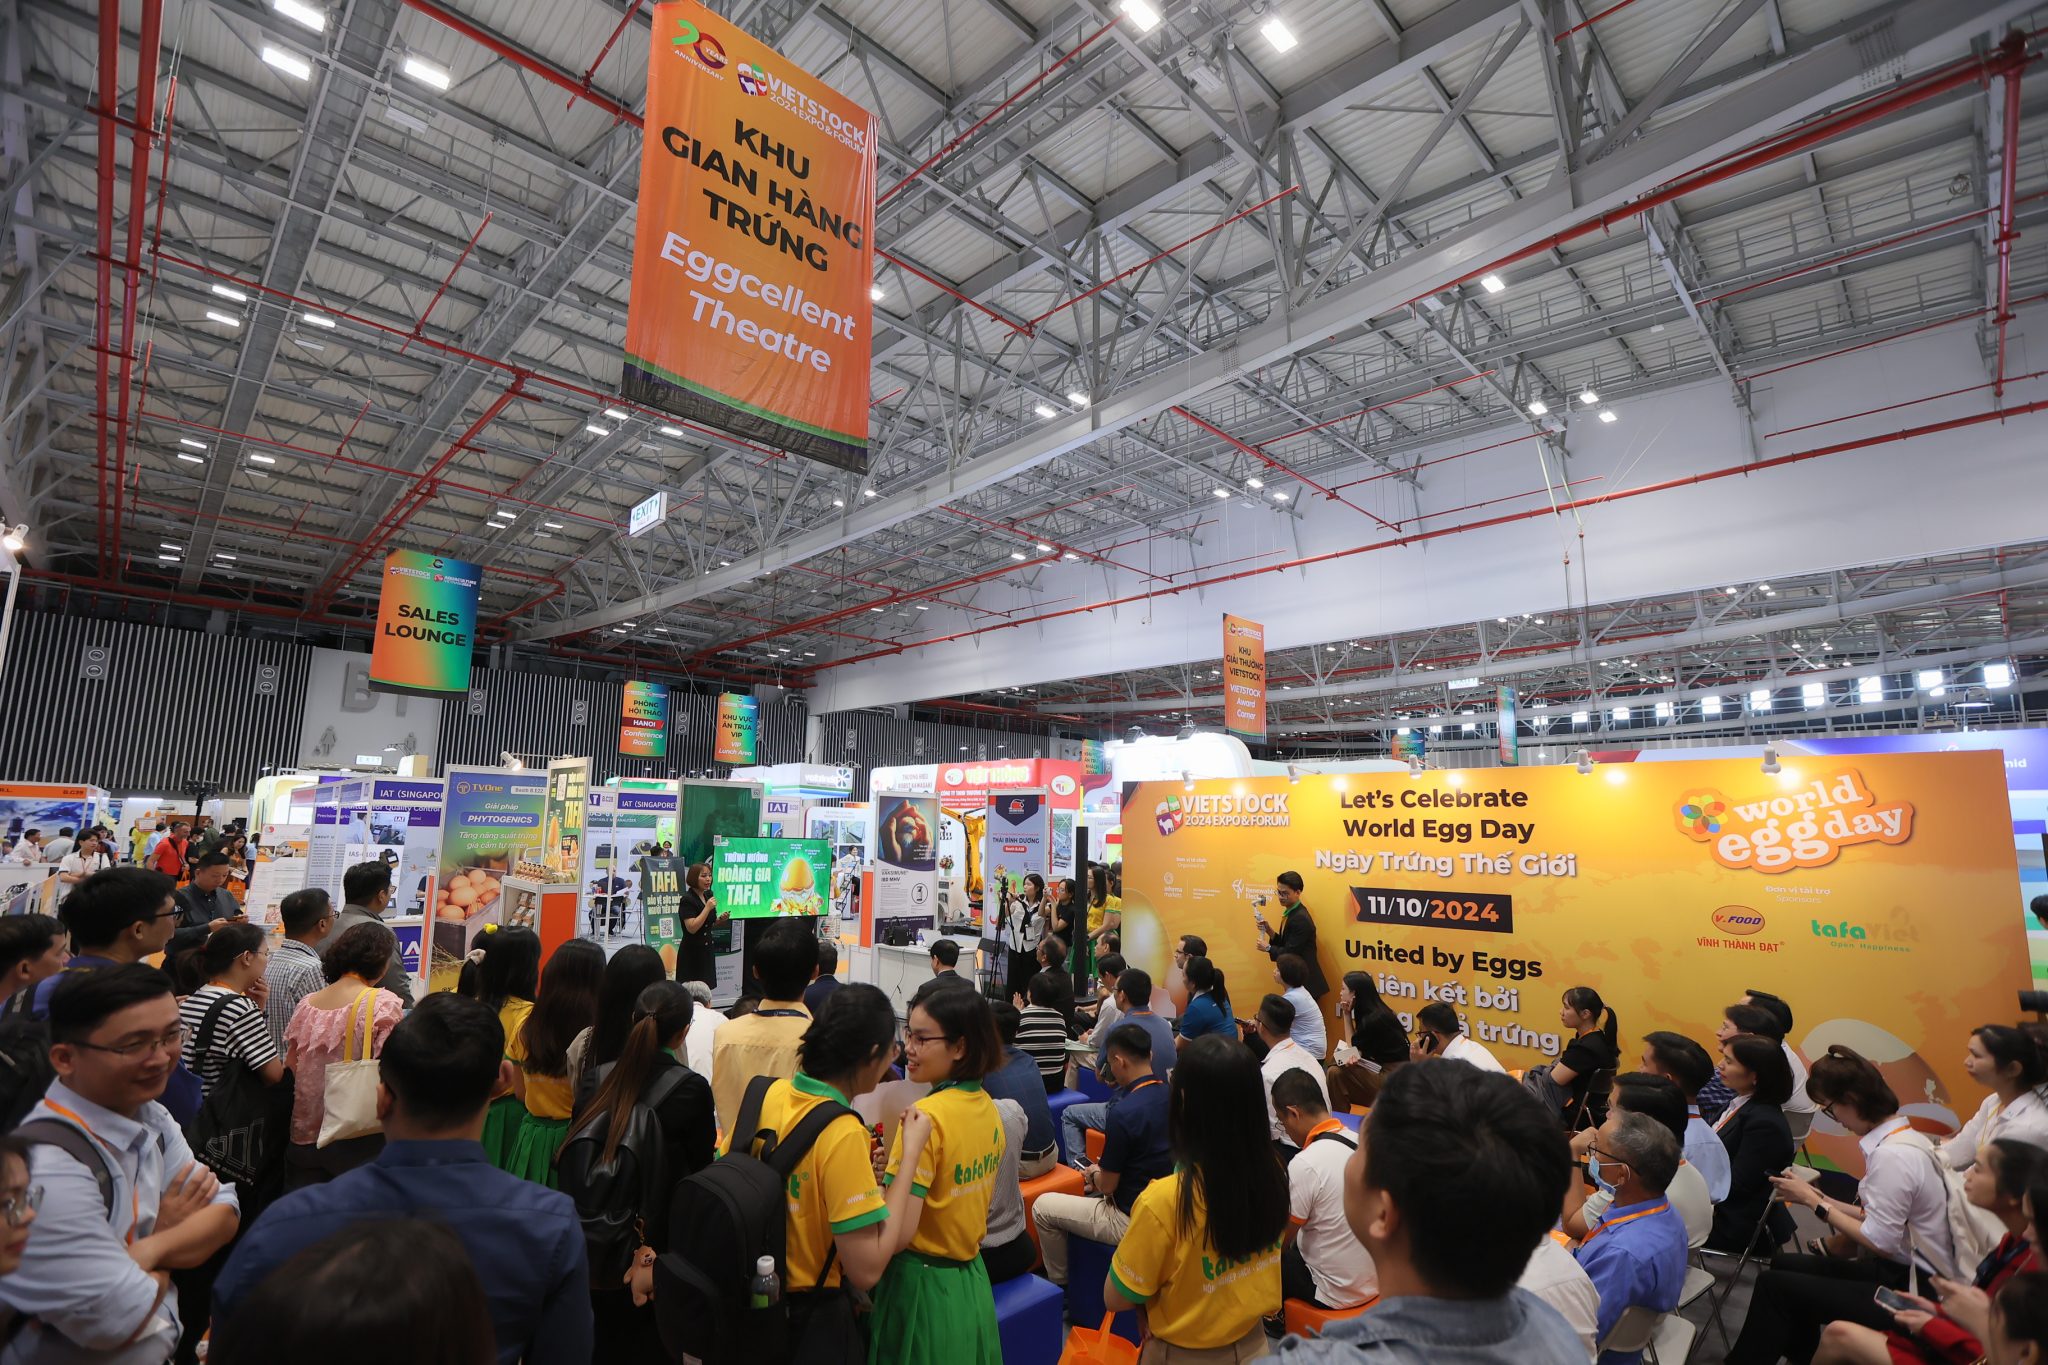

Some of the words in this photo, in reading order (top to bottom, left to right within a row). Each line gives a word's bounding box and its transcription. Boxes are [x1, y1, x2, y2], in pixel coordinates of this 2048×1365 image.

[674, 49, 724, 81] ANNIVERSARY
[705, 47, 729, 66] YEARS
[767, 72, 865, 147] VIETSTOCK
[769, 91, 797, 115] 2024
[735, 119, 810, 180] KHU
[662, 126, 757, 196] GIAN
[769, 181, 863, 249] HÀNG
[703, 189, 828, 272] TRỨNG
[660, 231, 856, 341] Eggcellent
[689, 289, 832, 372] Theatre
[636, 499, 655, 521] EXIT
[398, 604, 460, 626] SALES
[385, 623, 467, 647] LOUNGE
[1238, 646, 1251, 656] KHU
[1229, 667, 1261, 681] VIETSTOCK
[1230, 684, 1261, 697] VIETSTOCK
[1236, 698, 1256, 708] Award
[633, 720, 656, 728] HANOI
[1236, 709, 1256, 720] Corner
[624, 729, 663, 739] Conference
[632, 739, 654, 747] Room
[738, 749, 752, 757] Area
[380, 789, 395, 798] IAT
[1182, 793, 1289, 814] VIETSTOCK
[1341, 790, 1394, 809] Let's
[1400, 788, 1529, 808] Celebrate
[1733, 774, 1864, 823] world
[769, 803, 786, 812] IAT
[468, 815, 533, 824] PHYTOGENICS
[1185, 815, 1212, 826] 2024
[1344, 818, 1415, 838] World
[1423, 819, 1472, 843] Egg
[1480, 819, 1535, 844] Day
[1717, 812, 1829, 867] egg
[1823, 807, 1904, 840] day
[717, 864, 752, 883] HOÀNG
[755, 867, 772, 882] GIA
[1315, 849, 1374, 873] Ngày
[1379, 850, 1453, 877] Trứng
[1460, 850, 1515, 875] Thế
[1519, 852, 1577, 878] Giới
[650, 871, 678, 892] TAFA
[1765, 885, 1785, 894] Đơn
[1787, 886, 1799, 896] vị
[1800, 885, 1812, 895] tài
[1814, 886, 1831, 897] trợ
[727, 884, 761, 905] TAFA
[1367, 895, 1500, 923] 11/10/2024
[1697, 937, 1720, 948] VĨNH
[1722, 938, 1756, 951] THÀNH
[1831, 940, 1855, 949] Open
[1859, 943, 1912, 953] Happiness
[1345, 939, 1425, 965] United
[1432, 946, 1465, 974] by
[1472, 951, 1543, 981] Eggs
[1374, 973, 1416, 999] iên
[1423, 978, 1468, 1005] kết
[1475, 985, 1519, 1012] bởi
[1477, 1019, 1561, 1057] trứng
